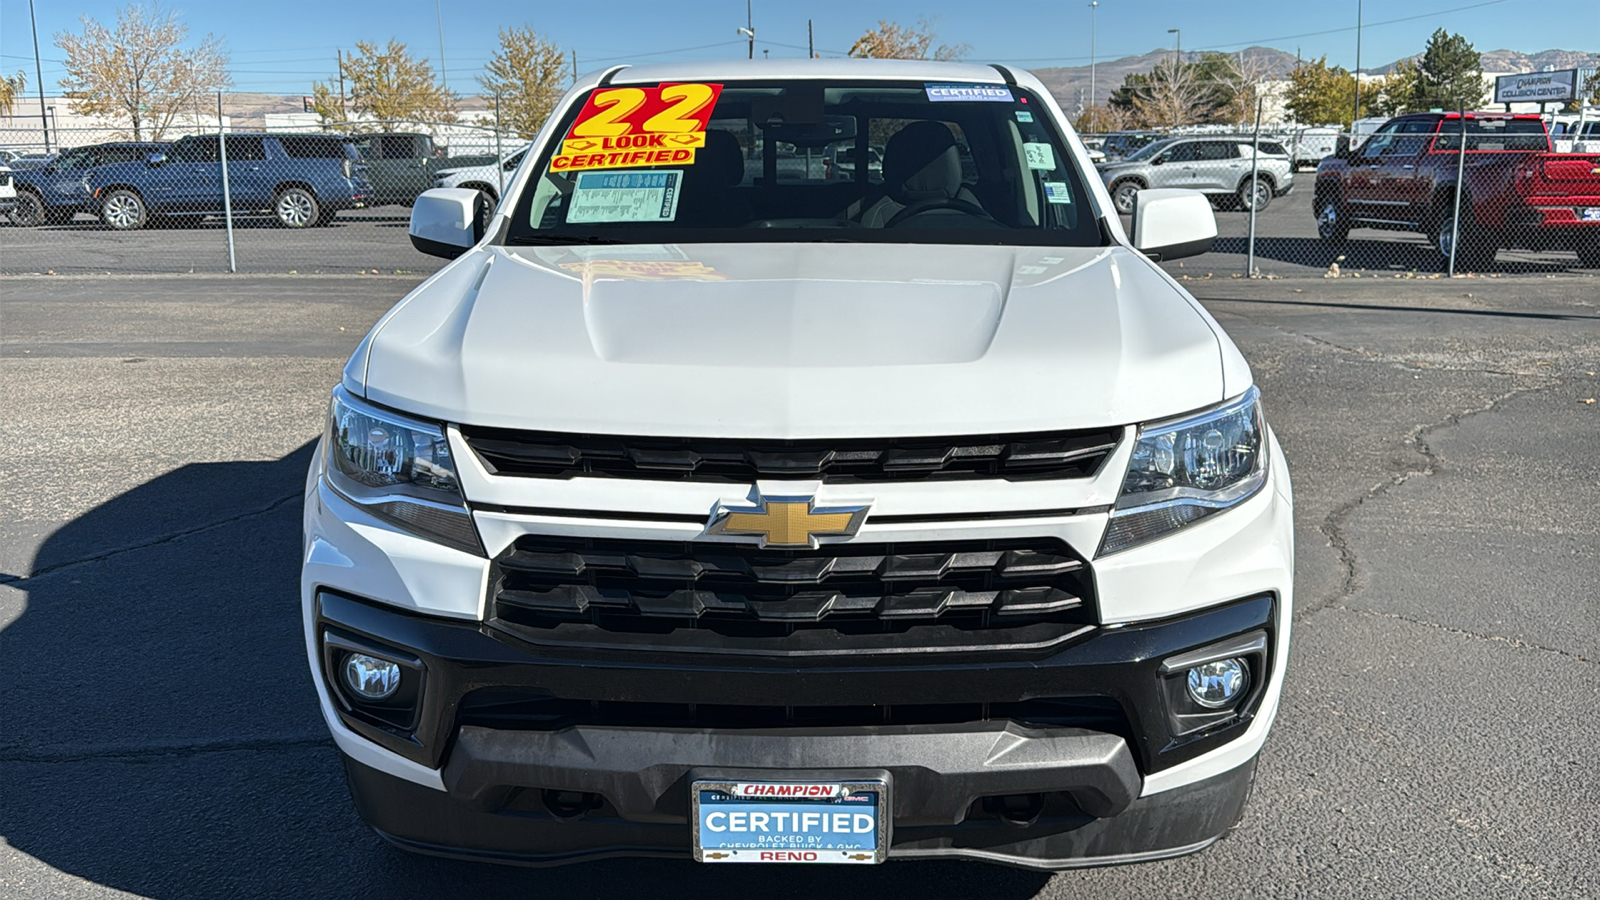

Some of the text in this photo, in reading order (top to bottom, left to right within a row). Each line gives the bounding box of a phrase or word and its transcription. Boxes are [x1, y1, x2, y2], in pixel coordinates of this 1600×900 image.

[1516, 77, 1552, 89] CHAMPION
[930, 88, 1007, 96] CERTIFIED
[1502, 87, 1566, 98] COLLISION CENTER
[573, 84, 714, 137] 22
[602, 134, 667, 150] LOOK
[552, 149, 692, 168] CERTIFIED
[662, 187, 674, 217] CERTIFIED
[743, 785, 834, 796] CHAMPION
[705, 812, 875, 834] CERTIFIED
[758, 835, 804, 843] BACKED
[760, 852, 818, 861] RENO
